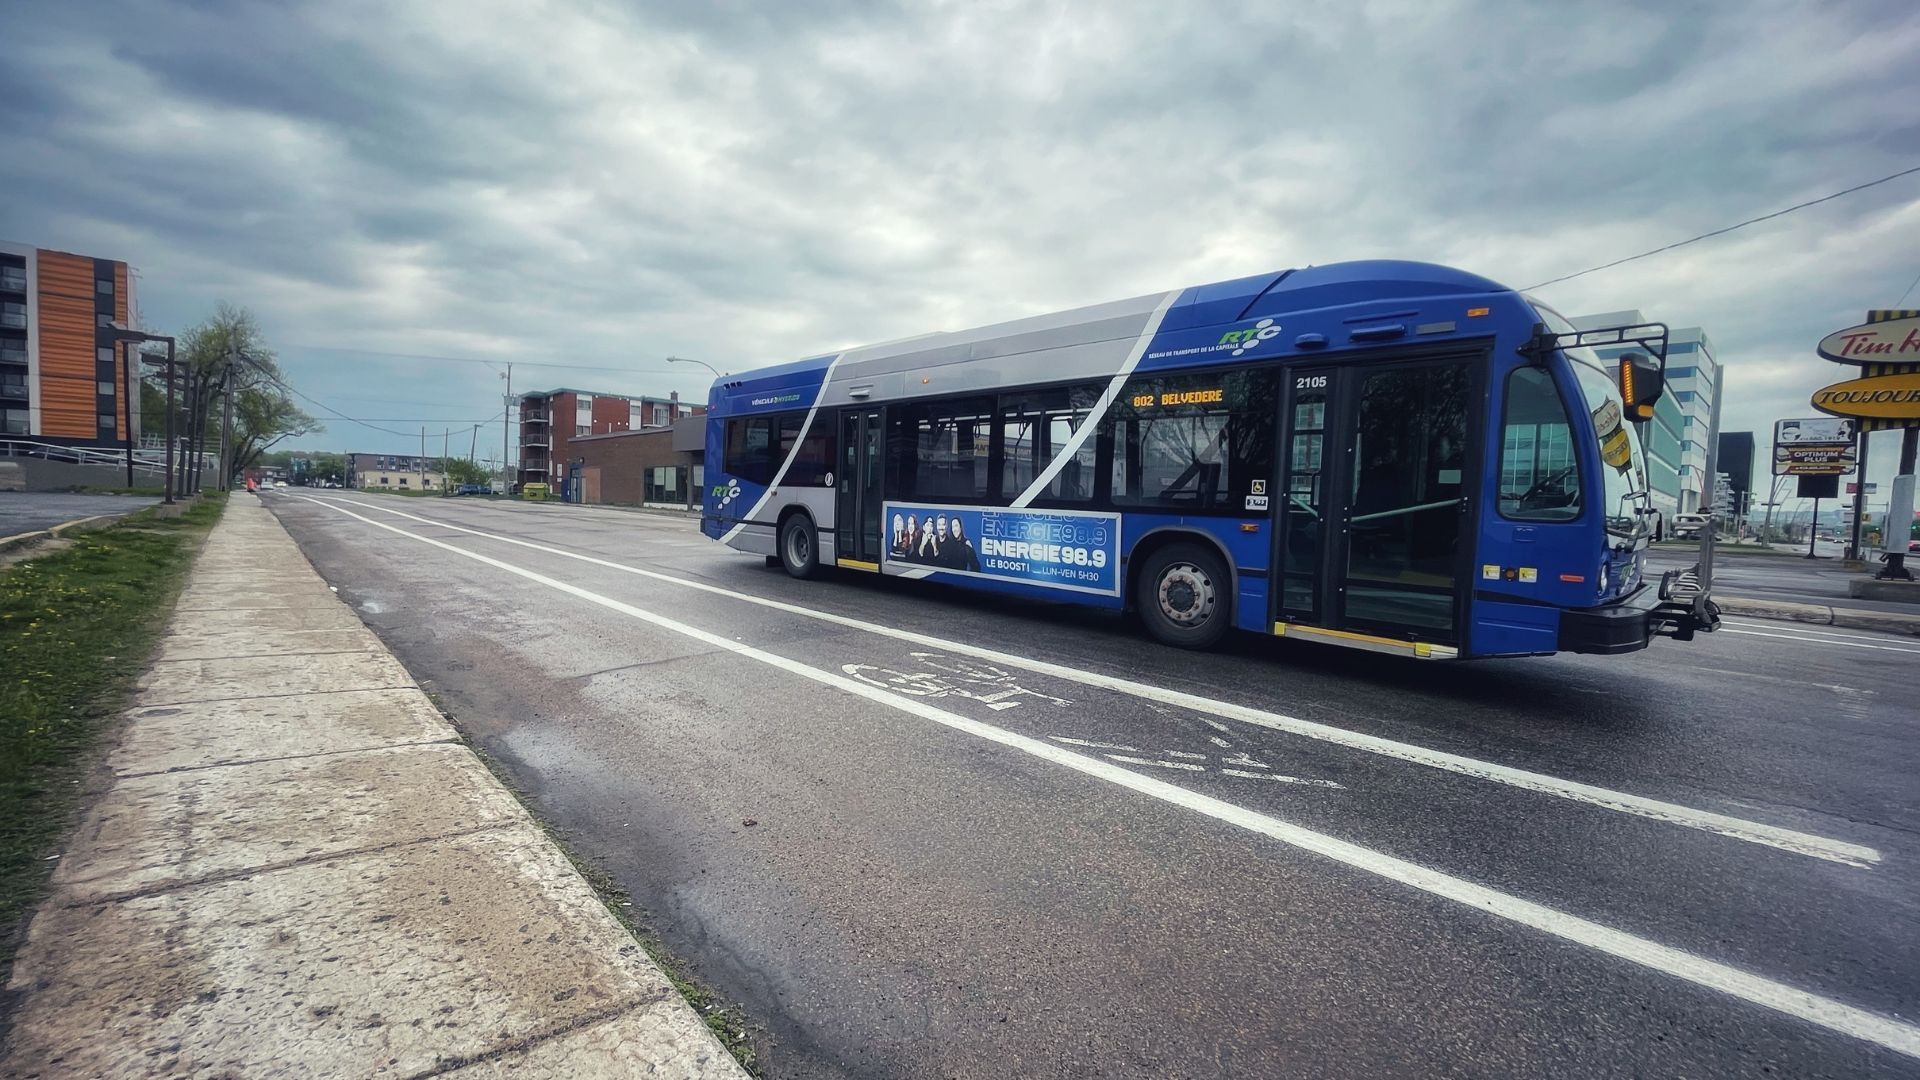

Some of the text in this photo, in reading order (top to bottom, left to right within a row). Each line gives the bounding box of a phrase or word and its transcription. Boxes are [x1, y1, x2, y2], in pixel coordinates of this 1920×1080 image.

[1219, 326, 1282, 344] RTC
[1173, 346, 1200, 356] TRANSPORT
[1208, 344, 1215, 352] LA
[1216, 341, 1239, 351] CAPITALE
[1840, 332, 1893, 356] Tim
[1297, 376, 1327, 389] 2105
[1133, 389, 1223, 407] 802 BELVEDERE
[712, 486, 741, 498] RTC
[986, 558, 996, 568] LE
[1042, 566, 1099, 582] LUN-VEN 5H30
